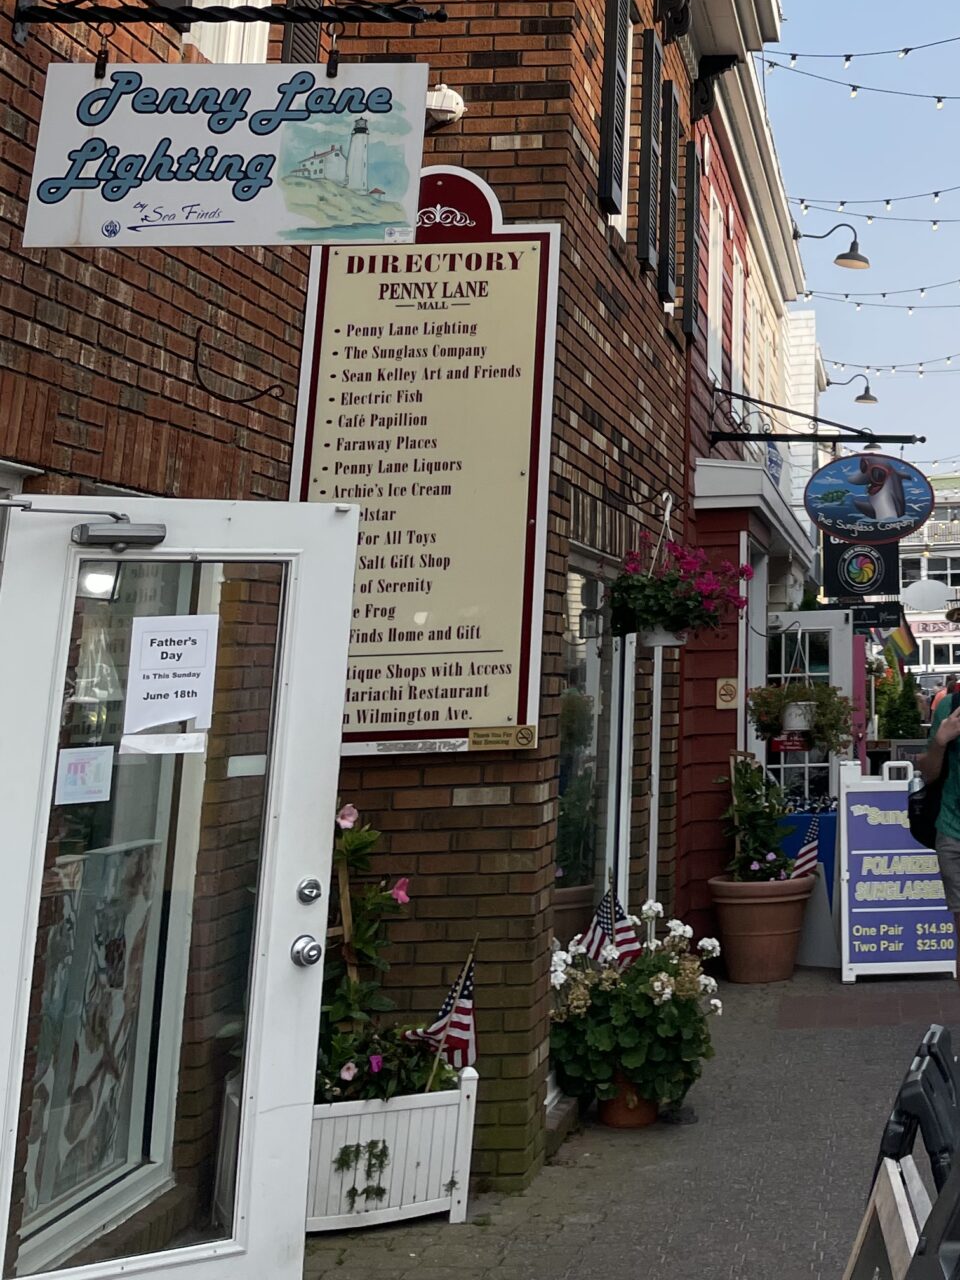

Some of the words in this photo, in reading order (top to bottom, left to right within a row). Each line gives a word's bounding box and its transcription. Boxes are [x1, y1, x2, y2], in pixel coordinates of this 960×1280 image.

[76, 71, 251, 134] Penny
[249, 71, 393, 135] Lane
[37, 137, 277, 202] Lighting
[133, 201, 149, 213] by
[141, 206, 177, 223] Sea
[181, 203, 223, 220] Finds
[346, 250, 525, 275] DIRECTORY
[378, 281, 439, 300] PENNY
[441, 280, 489, 299] LANE
[417, 301, 449, 311] MALL
[346, 323, 384, 339] Penny
[389, 322, 419, 337] Lane
[423, 321, 478, 338] Lighting
[344, 346, 369, 360] The
[371, 345, 428, 361] Sunglass
[432, 344, 487, 360] Company
[341, 369, 373, 383] Sean
[376, 367, 417, 383] Kelley
[421, 366, 442, 381] Art
[446, 366, 470, 380] and
[473, 364, 522, 379] Friends
[340, 391, 393, 406] Electric
[396, 389, 424, 404] Fish
[337, 414, 366, 429] Café
[370, 413, 428, 429] Papillion
[336, 437, 392, 454] Faraway
[396, 435, 438, 450] Places
[334, 461, 372, 477] Penny
[378, 460, 409, 474] Lane
[413, 459, 463, 475] Liquors
[332, 484, 384, 498] Archie's
[388, 483, 407, 497] Ice
[411, 483, 452, 497] Cream
[836, 519, 874, 537] Sunglass
[357, 531, 380, 546] For
[384, 530, 402, 545] All
[407, 530, 437, 547] Toys
[358, 555, 386, 570] Salt
[390, 554, 415, 569] Gift
[420, 553, 451, 571] Shop
[360, 579, 374, 594] of
[377, 578, 433, 595] Serenity
[365, 603, 397, 621] Frog
[149, 637, 198, 648] Father's
[349, 628, 383, 644] Finds
[388, 627, 424, 642] Home
[428, 626, 452, 641] and
[456, 624, 482, 640] Gift
[160, 651, 183, 662] Day
[172, 671, 201, 680] Sunday
[346, 665, 382, 683] tique
[386, 663, 427, 682] Shops
[431, 661, 463, 678] with
[467, 662, 513, 677] Access
[142, 691, 170, 701] June
[174, 690, 198, 699] 18th
[408, 682, 490, 701] Restaurant
[356, 707, 440, 726] Wilmington
[444, 707, 473, 722] Ave.
[854, 880, 946, 901] SUNGLASSE
[852, 925, 878, 937] One
[880, 924, 904, 936] Pair
[915, 922, 954, 935] $14.99
[853, 941, 878, 952] Two
[880, 940, 904, 952] Pair
[916, 938, 955, 951] $25.00
